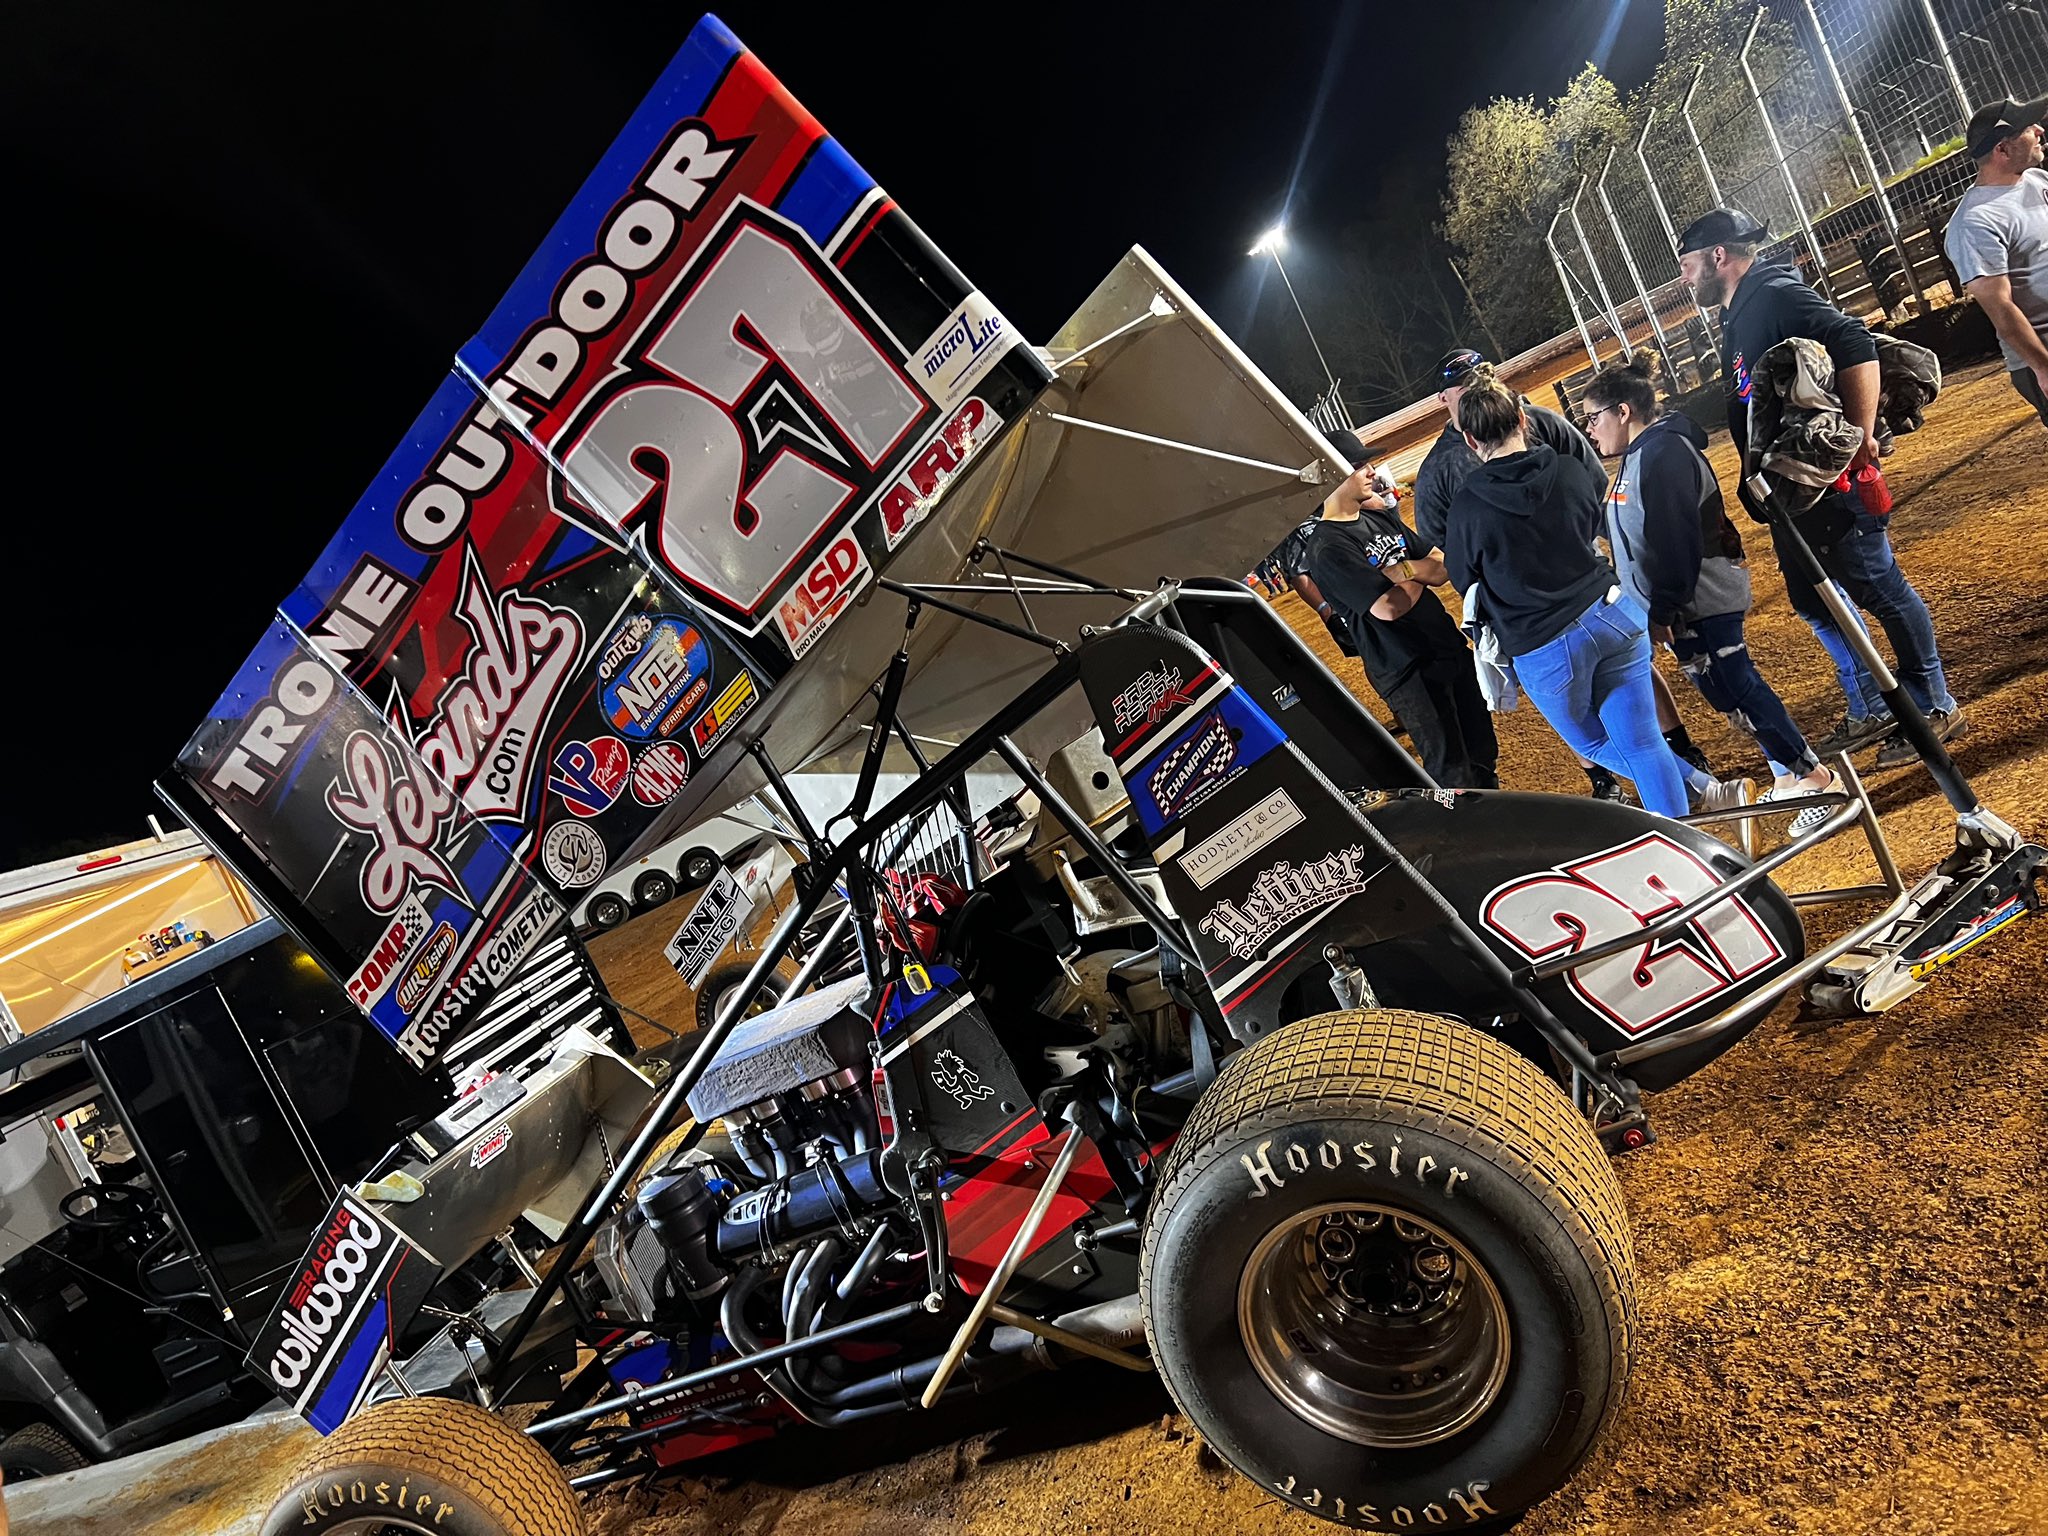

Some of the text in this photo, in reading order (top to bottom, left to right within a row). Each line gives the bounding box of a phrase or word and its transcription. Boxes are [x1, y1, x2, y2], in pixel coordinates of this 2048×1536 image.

[556, 206, 932, 622] 27
[212, 128, 736, 796] TRONE OUTDOOR
[883, 398, 986, 540] ARP
[780, 538, 858, 642] MSD
[598, 614, 653, 679] OUTLAWS
[795, 620, 827, 657] PRO MAG
[616, 625, 687, 723] NOS
[640, 670, 693, 731] ENERGY DRINK
[694, 668, 754, 743] KSE
[660, 681, 707, 736] SPRINT CARS
[486, 727, 527, 804] .com
[548, 740, 614, 813] VP
[595, 744, 623, 791] Racing
[631, 743, 657, 773] TRADING
[634, 745, 686, 803] ACME
[699, 733, 721, 755] RACING
[1166, 730, 1218, 800] CHAMPION
[663, 774, 690, 805] COMPANY
[1177, 802, 1193, 814] MADE
[1200, 788, 1212, 798] USA
[1212, 776, 1227, 789] SINCE
[1186, 820, 1255, 873] HODNETT
[396, 923, 424, 964] CAMS
[486, 891, 556, 976] COMETIC
[674, 880, 727, 964] NNT
[699, 909, 736, 961] MFG
[1241, 882, 1367, 959] RACING ENTERPRISES
[1482, 832, 1784, 1039] 27
[348, 922, 407, 1006] COMP
[500, 946, 528, 978] GASKET
[398, 959, 489, 1069] Hoosier
[478, 1136, 507, 1161] WING
[1239, 1133, 1471, 1199] Hoosier
[302, 1209, 352, 1297] RACING
[270, 1198, 382, 1388] wilwood
[642, 1388, 748, 1424] CONCESSIONS
[302, 1476, 456, 1525] Hoosier
[1273, 1475, 1501, 1528] Hoosier
